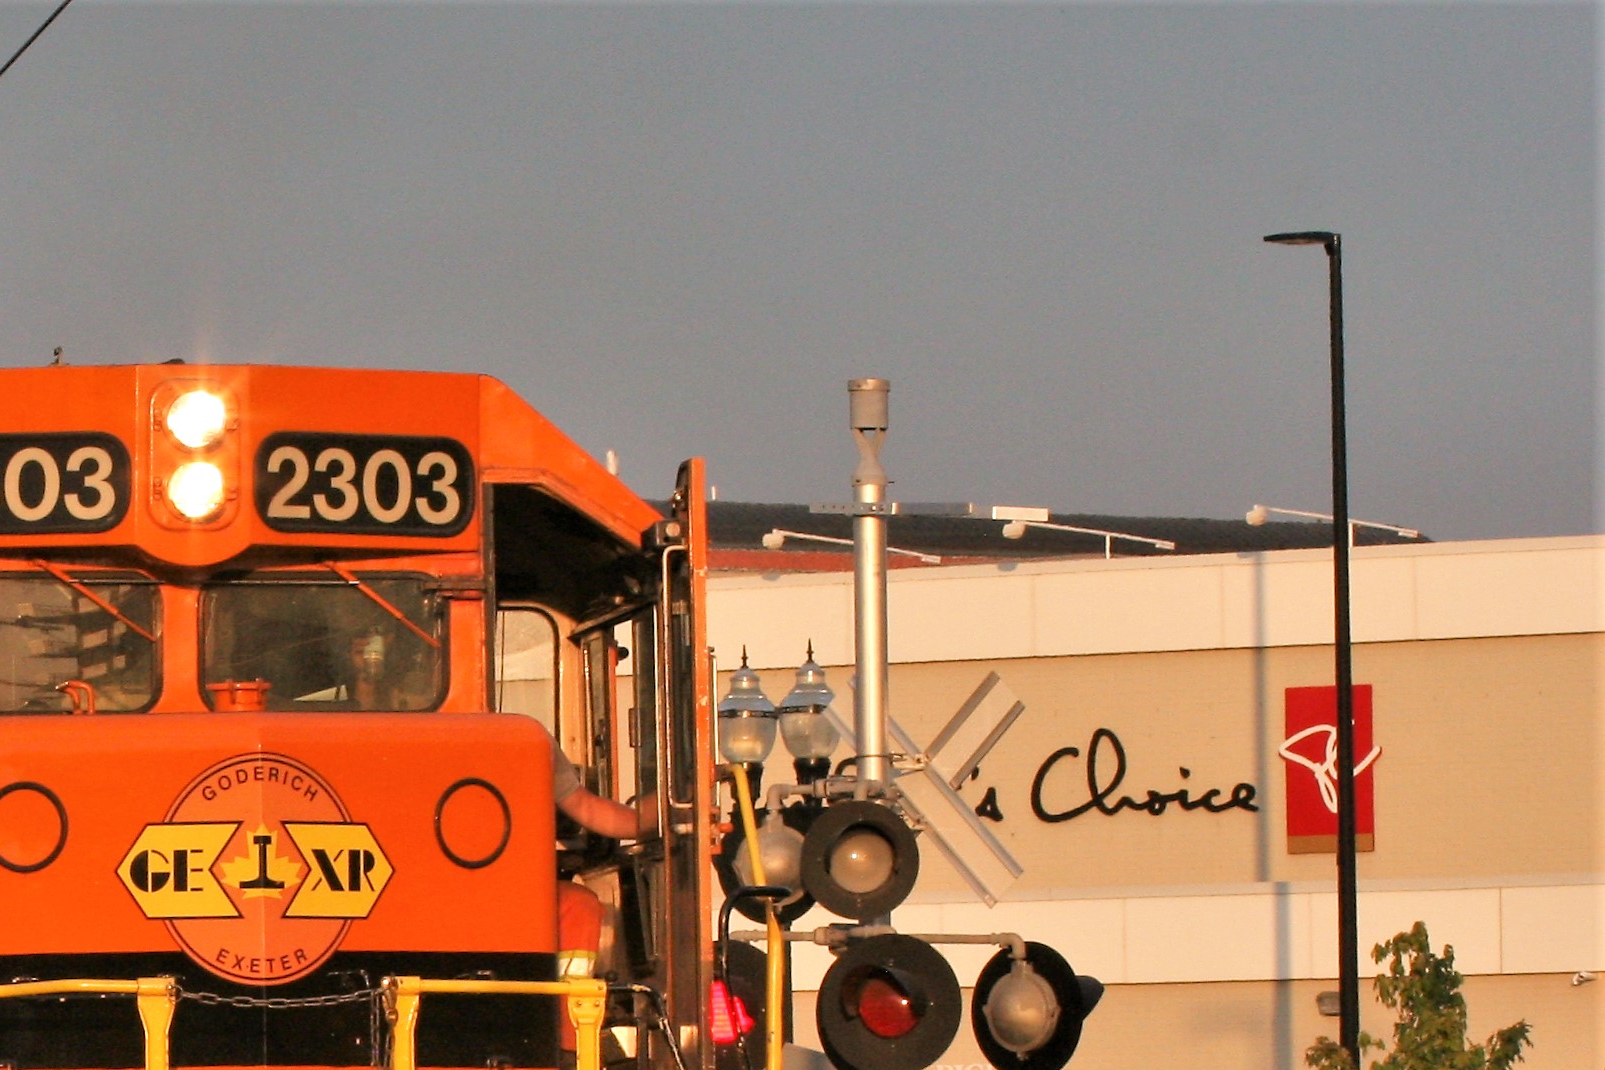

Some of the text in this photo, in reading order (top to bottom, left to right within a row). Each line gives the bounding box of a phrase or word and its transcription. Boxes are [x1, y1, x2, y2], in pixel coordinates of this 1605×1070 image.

[267, 446, 460, 525] 2303
[201, 766, 318, 801] GODERICH
[1031, 727, 1259, 823] Choice
[129, 849, 376, 893] GE XR
[215, 948, 308, 974] EXETER
